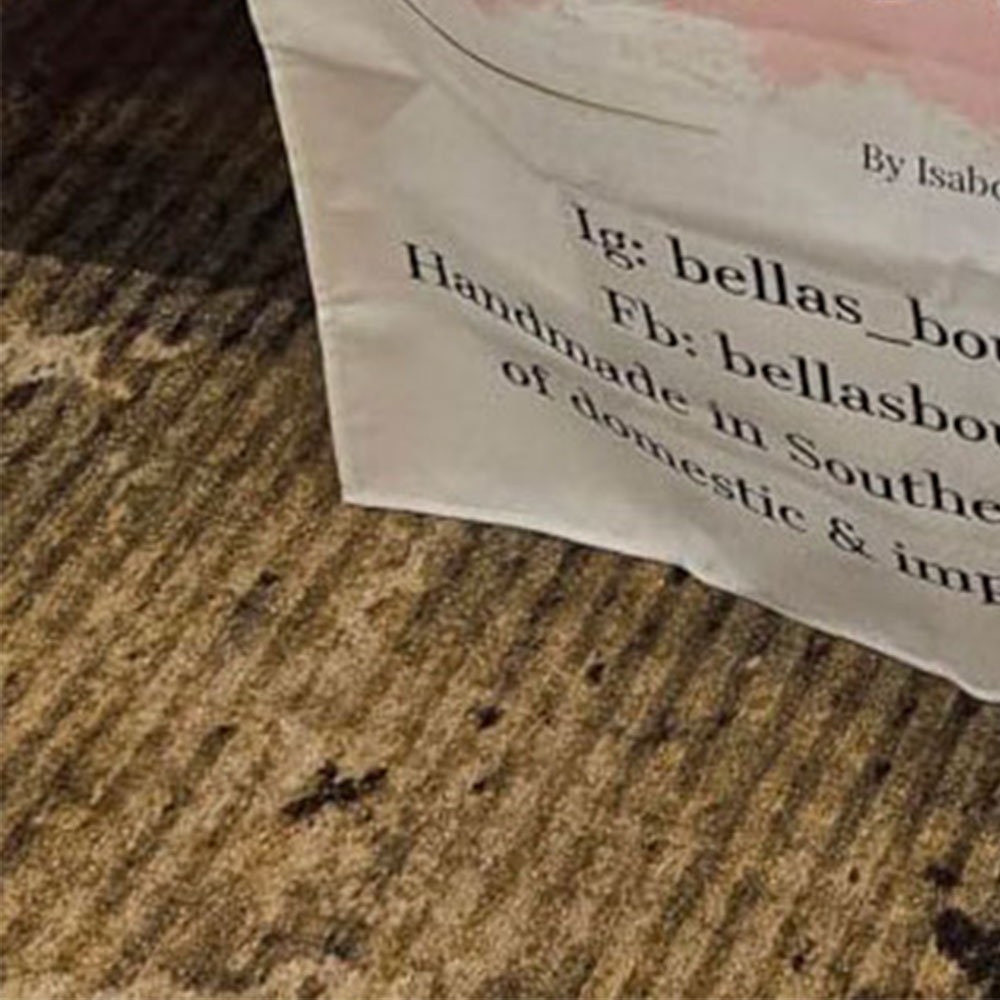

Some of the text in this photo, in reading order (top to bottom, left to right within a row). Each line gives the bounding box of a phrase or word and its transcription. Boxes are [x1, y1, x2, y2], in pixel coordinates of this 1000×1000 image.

[862, 142, 905, 182] By
[570, 202, 648, 270] Ig:
[403, 241, 690, 414] Handmade
[710, 400, 769, 452] in
[602, 287, 698, 357] Fb:
[501, 359, 552, 398] of
[570, 389, 807, 533] domestic
[828, 515, 874, 558] &
